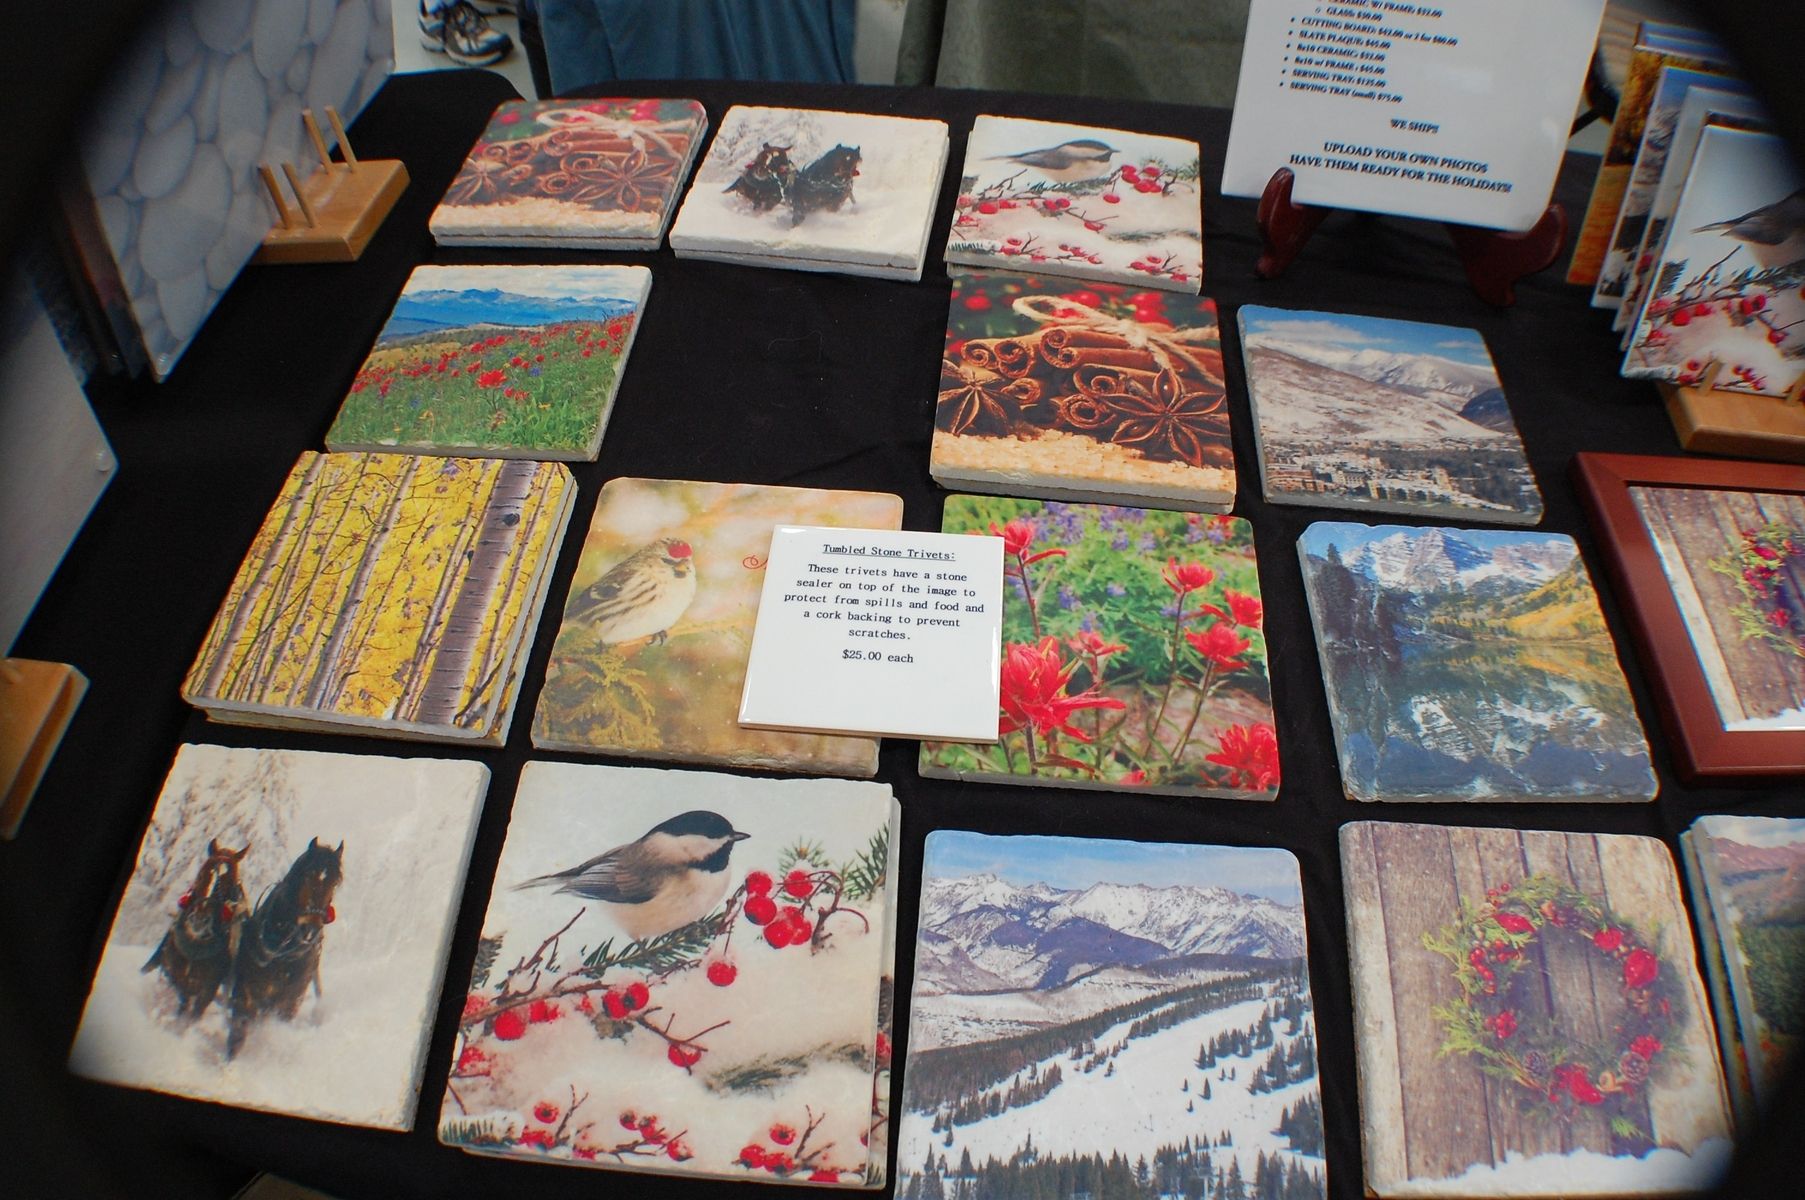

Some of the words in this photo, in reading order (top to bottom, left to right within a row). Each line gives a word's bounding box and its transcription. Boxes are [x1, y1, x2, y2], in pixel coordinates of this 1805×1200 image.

[1301, 16, 1342, 30] CUTTING
[1299, 29, 1326, 41] SLATE
[1292, 68, 1329, 81] SERVING
[1290, 80, 1328, 94] SERVING
[1329, 85, 1351, 97] TRAY
[1390, 118, 1407, 131] WE
[1324, 142, 1372, 157] UPLOAD
[1374, 148, 1407, 162] YOUR
[1409, 152, 1439, 166] OWN
[1440, 157, 1488, 173] PHOTOS
[1290, 154, 1322, 167] HAVE
[1324, 157, 1358, 172] THEM
[1361, 163, 1400, 178] READY
[1401, 168, 1425, 181] FOR
[1427, 171, 1451, 185] THE
[823, 544, 866, 555] Tumbled
[871, 546, 902, 557] Stone
[907, 549, 956, 560] Trivets:
[808, 564, 839, 574] These
[845, 566, 887, 576] trivets
[893, 569, 919, 579] have
[936, 572, 967, 582] stone
[796, 579, 833, 589] sealer
[858, 583, 877, 592] top
[882, 583, 894, 592] of
[901, 584, 920, 594] the
[927, 585, 957, 597] image
[963, 588, 976, 597] to
[784, 593, 827, 603] protect
[835, 595, 859, 605] from
[865, 597, 903, 608] spills
[909, 600, 928, 609] and
[934, 601, 959, 611] food
[965, 602, 984, 612] and
[816, 610, 842, 620] cork
[847, 612, 892, 624] backing
[899, 615, 911, 624] to
[916, 617, 960, 627] prevent
[848, 629, 911, 640] scratches.
[842, 649, 881, 660] $25.00
[887, 653, 914, 663] each
